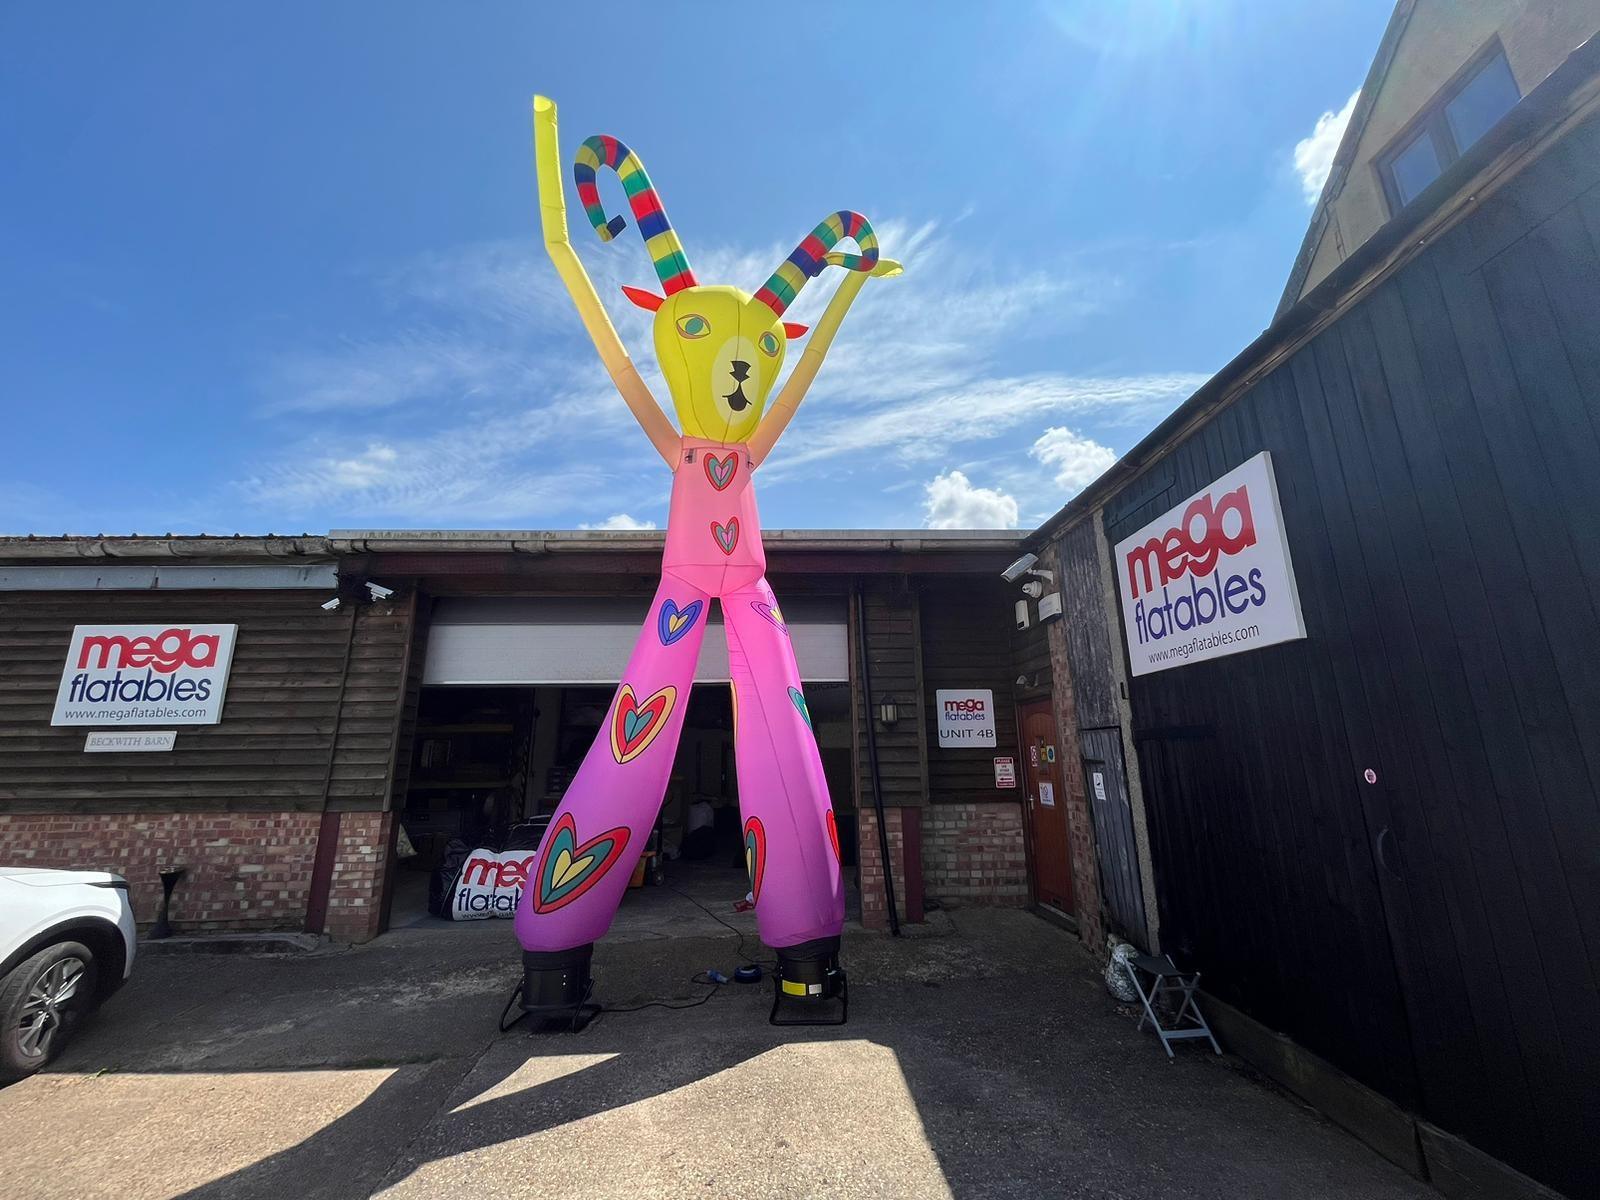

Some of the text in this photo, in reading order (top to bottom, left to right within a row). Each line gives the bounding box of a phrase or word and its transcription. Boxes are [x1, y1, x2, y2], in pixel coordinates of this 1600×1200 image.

[1127, 485, 1257, 599] mega
[1135, 568, 1266, 644] flatables
[77, 628, 220, 673] mega
[1149, 623, 1260, 664] www.megaflatables.com
[69, 667, 212, 702] flatables
[65, 706, 206, 721] www.megaflatables.com
[944, 699, 985, 712] mega
[945, 711, 986, 721] flatables
[90, 736, 172, 747] BECKWITH BARN
[940, 729, 994, 738] UNIT 4B
